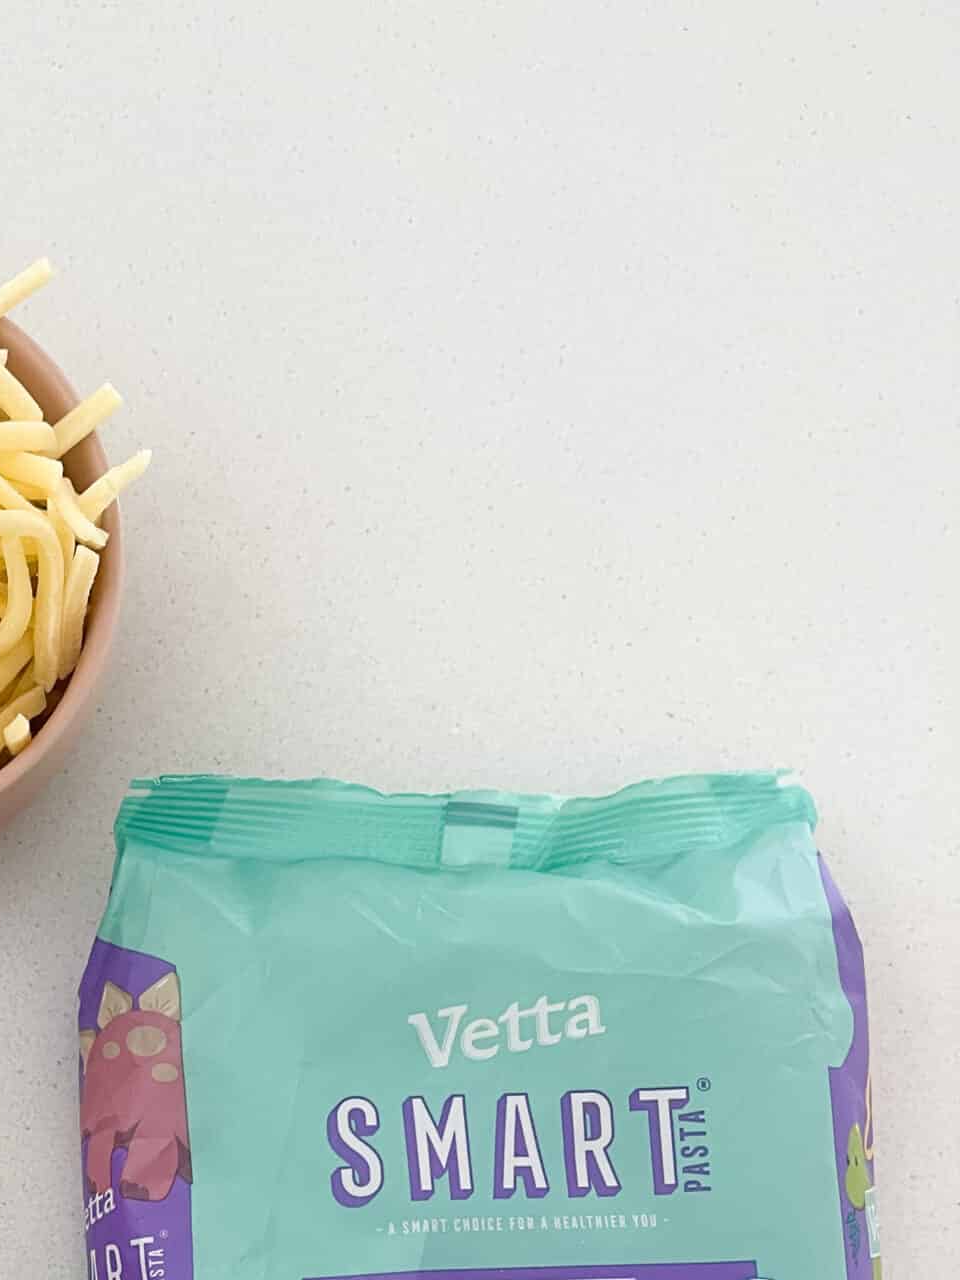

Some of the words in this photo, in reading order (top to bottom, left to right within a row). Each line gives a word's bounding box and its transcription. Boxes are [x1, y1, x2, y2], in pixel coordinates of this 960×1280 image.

[407, 993, 606, 1068] Vetta
[326, 1086, 690, 1206] SMART
[387, 1222, 397, 1235] A
[402, 1218, 448, 1234] SMART
[453, 1216, 504, 1232] CHOICE
[509, 1216, 535, 1230] FOR
[540, 1215, 548, 1230] A
[553, 1214, 627, 1230] HEALTHIER
[632, 1214, 657, 1228] YOU
